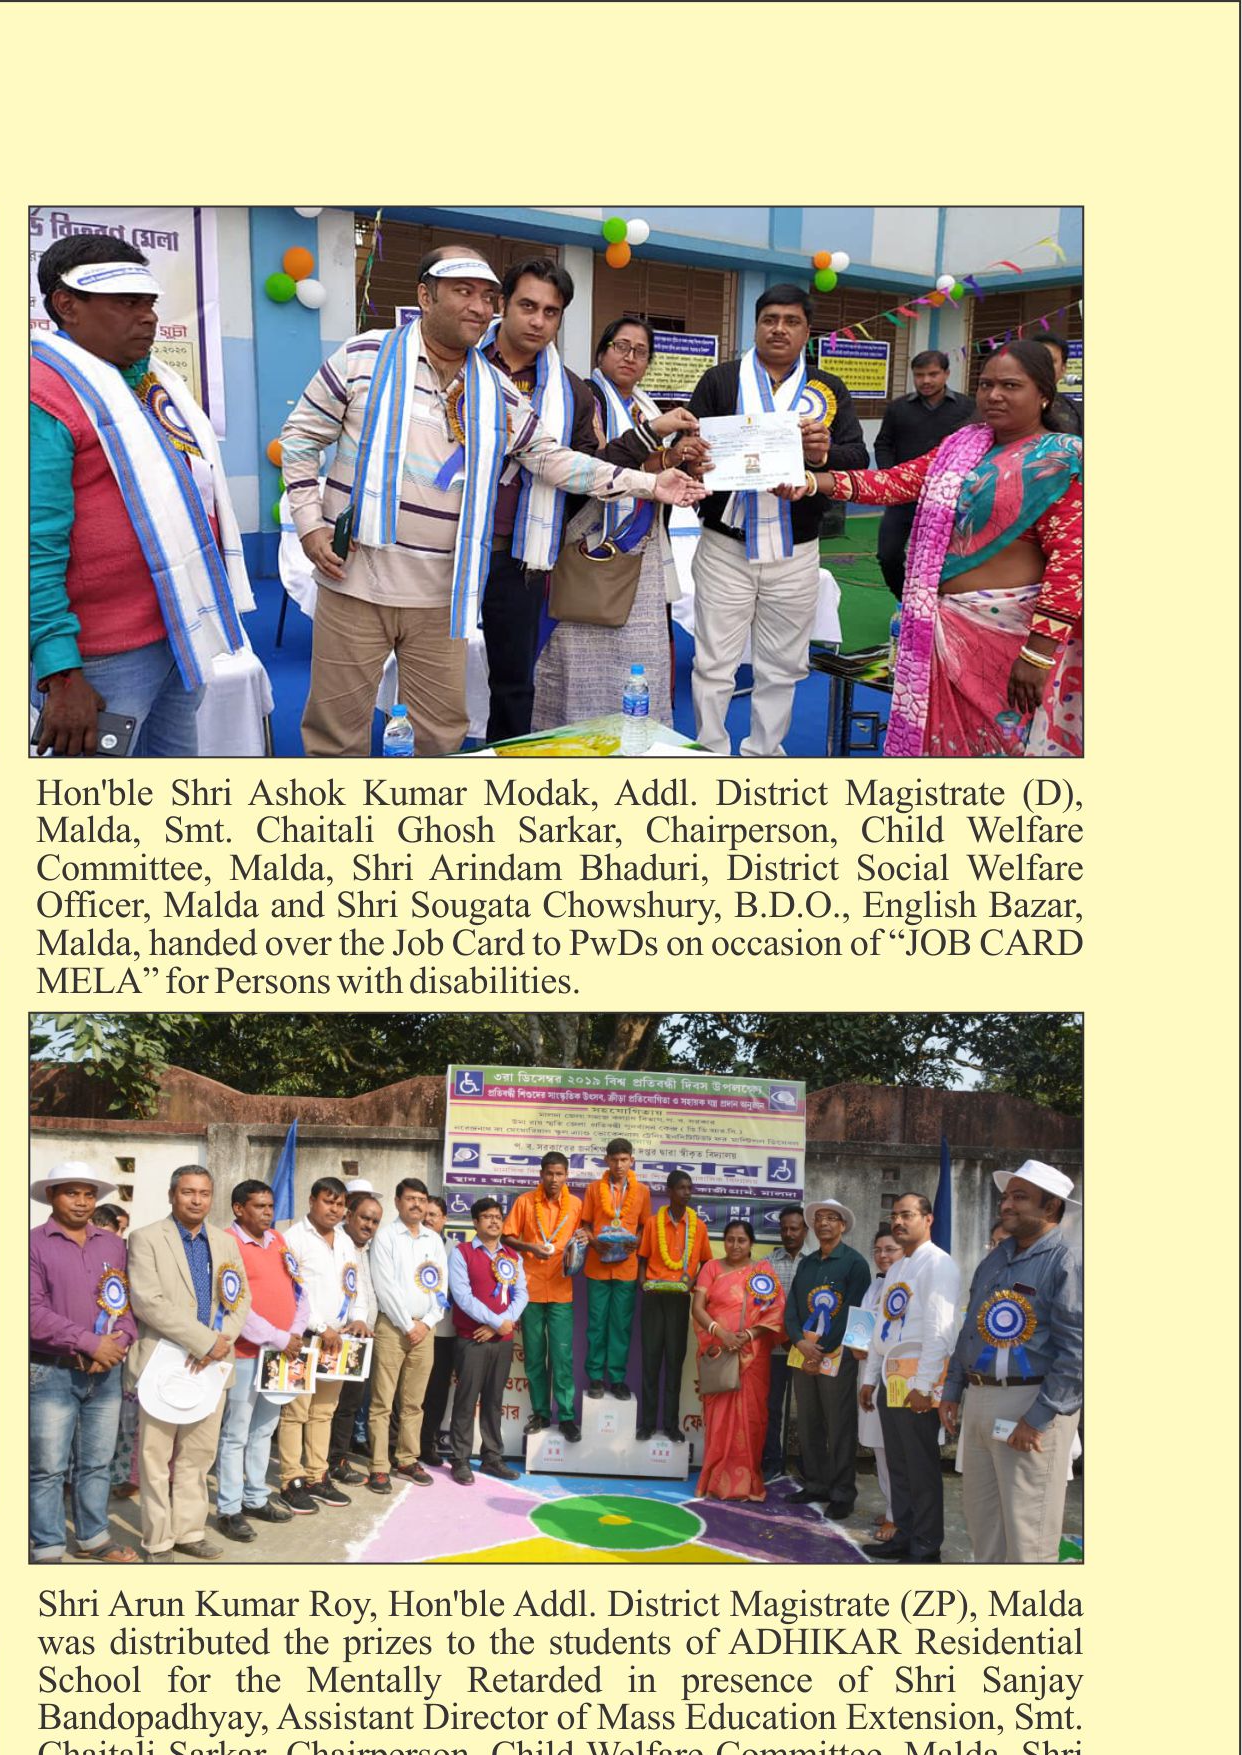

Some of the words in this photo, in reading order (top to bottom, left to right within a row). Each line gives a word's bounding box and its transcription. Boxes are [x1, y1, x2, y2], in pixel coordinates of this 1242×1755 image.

[132, 228, 179, 251] মেলা
[36, 815, 141, 849] Malda,
[165, 815, 232, 844] Smt.
[256, 815, 375, 844] Chaitali
[397, 815, 496, 844] Ghosh
[519, 815, 622, 849] Sarkar,
[646, 815, 838, 851] Chairperson,
[861, 815, 945, 844] Child
[966, 815, 1084, 844] Welfare
[493, 1072, 513, 1083] ৩রা
[518, 1071, 562, 1084] ডিসেম্বর
[567, 1075, 601, 1086] ২০১৯
[604, 1074, 626, 1088] বিশ্ব
[633, 1076, 676, 1090] প্রতিবন্ধী
[682, 1079, 708, 1092] দিবস
